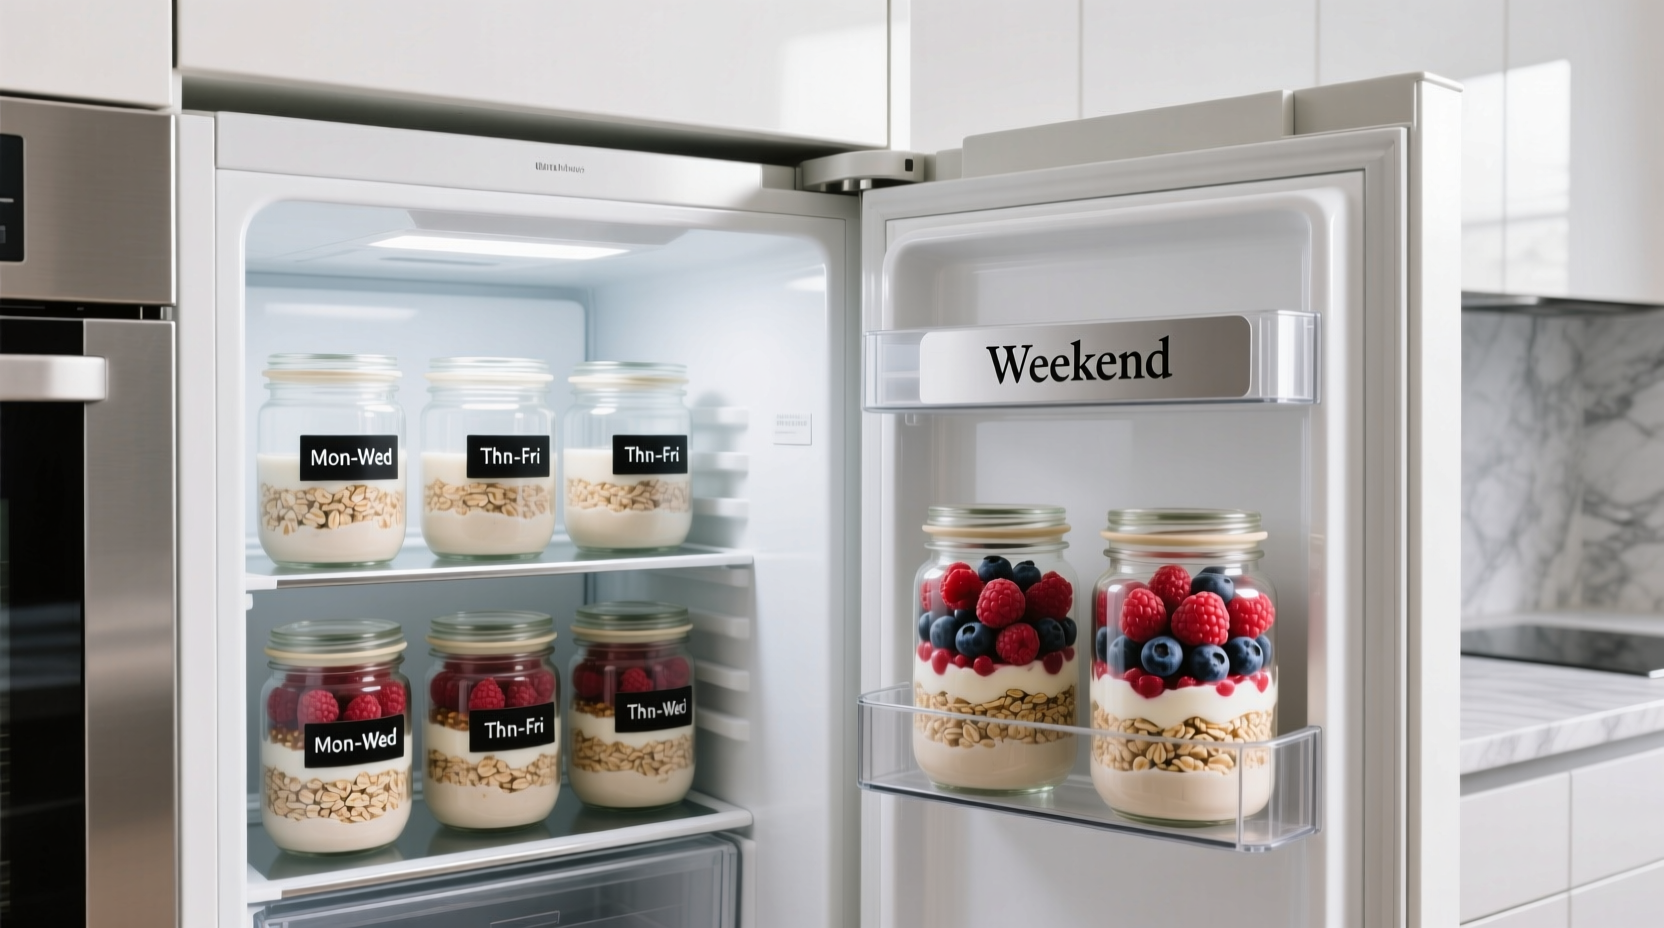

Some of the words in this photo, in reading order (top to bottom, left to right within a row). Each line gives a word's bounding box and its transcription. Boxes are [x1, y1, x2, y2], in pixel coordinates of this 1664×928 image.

[986, 335, 1173, 385] Weekend
[311, 447, 392, 466] Mon-Wed
[480, 446, 541, 465] Thn-Fri
[624, 446, 680, 463] Thn-Fri
[484, 716, 544, 739] Thn-Fri
[315, 726, 397, 754] Mon-Wed
